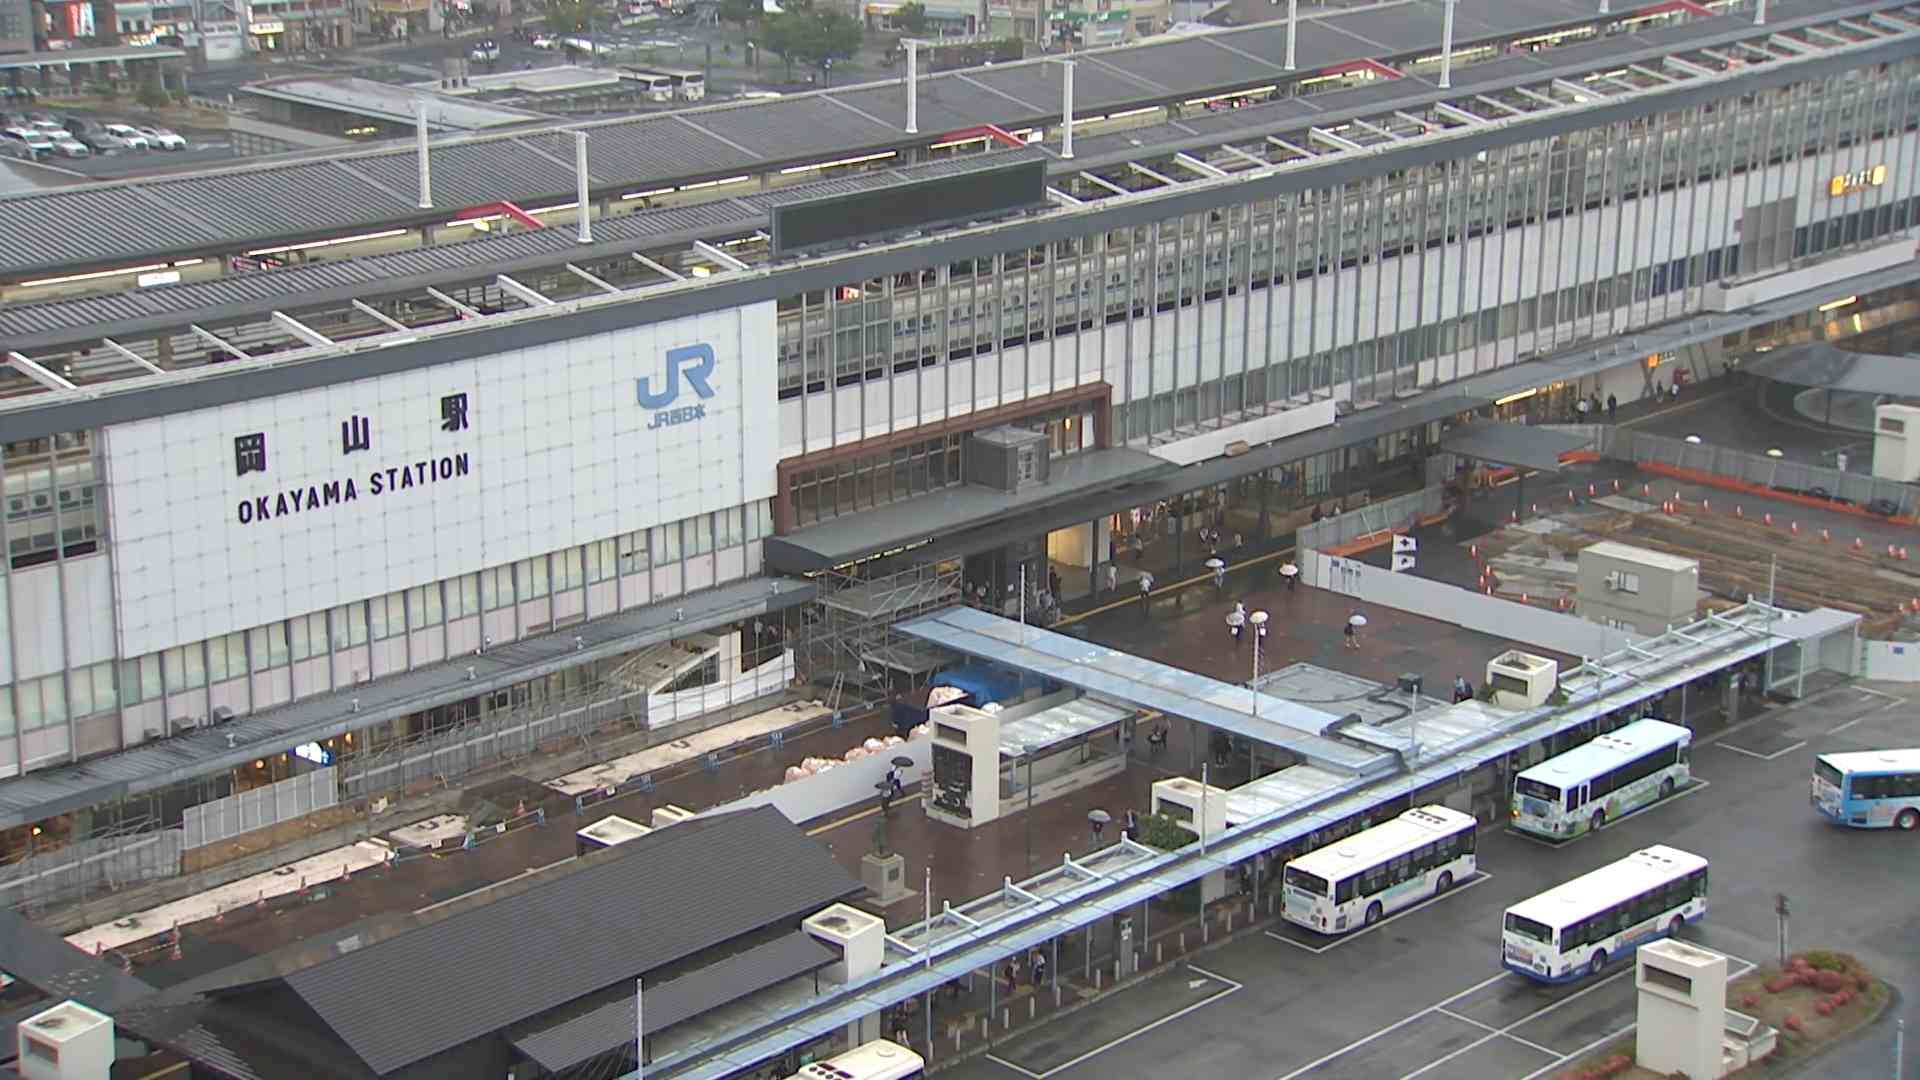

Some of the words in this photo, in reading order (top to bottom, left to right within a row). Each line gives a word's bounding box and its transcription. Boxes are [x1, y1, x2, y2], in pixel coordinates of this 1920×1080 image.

[637, 343, 715, 409] JR
[234, 392, 469, 477] 岡山駅
[238, 478, 357, 524] OKAYAMA
[370, 452, 469, 495] STATION
